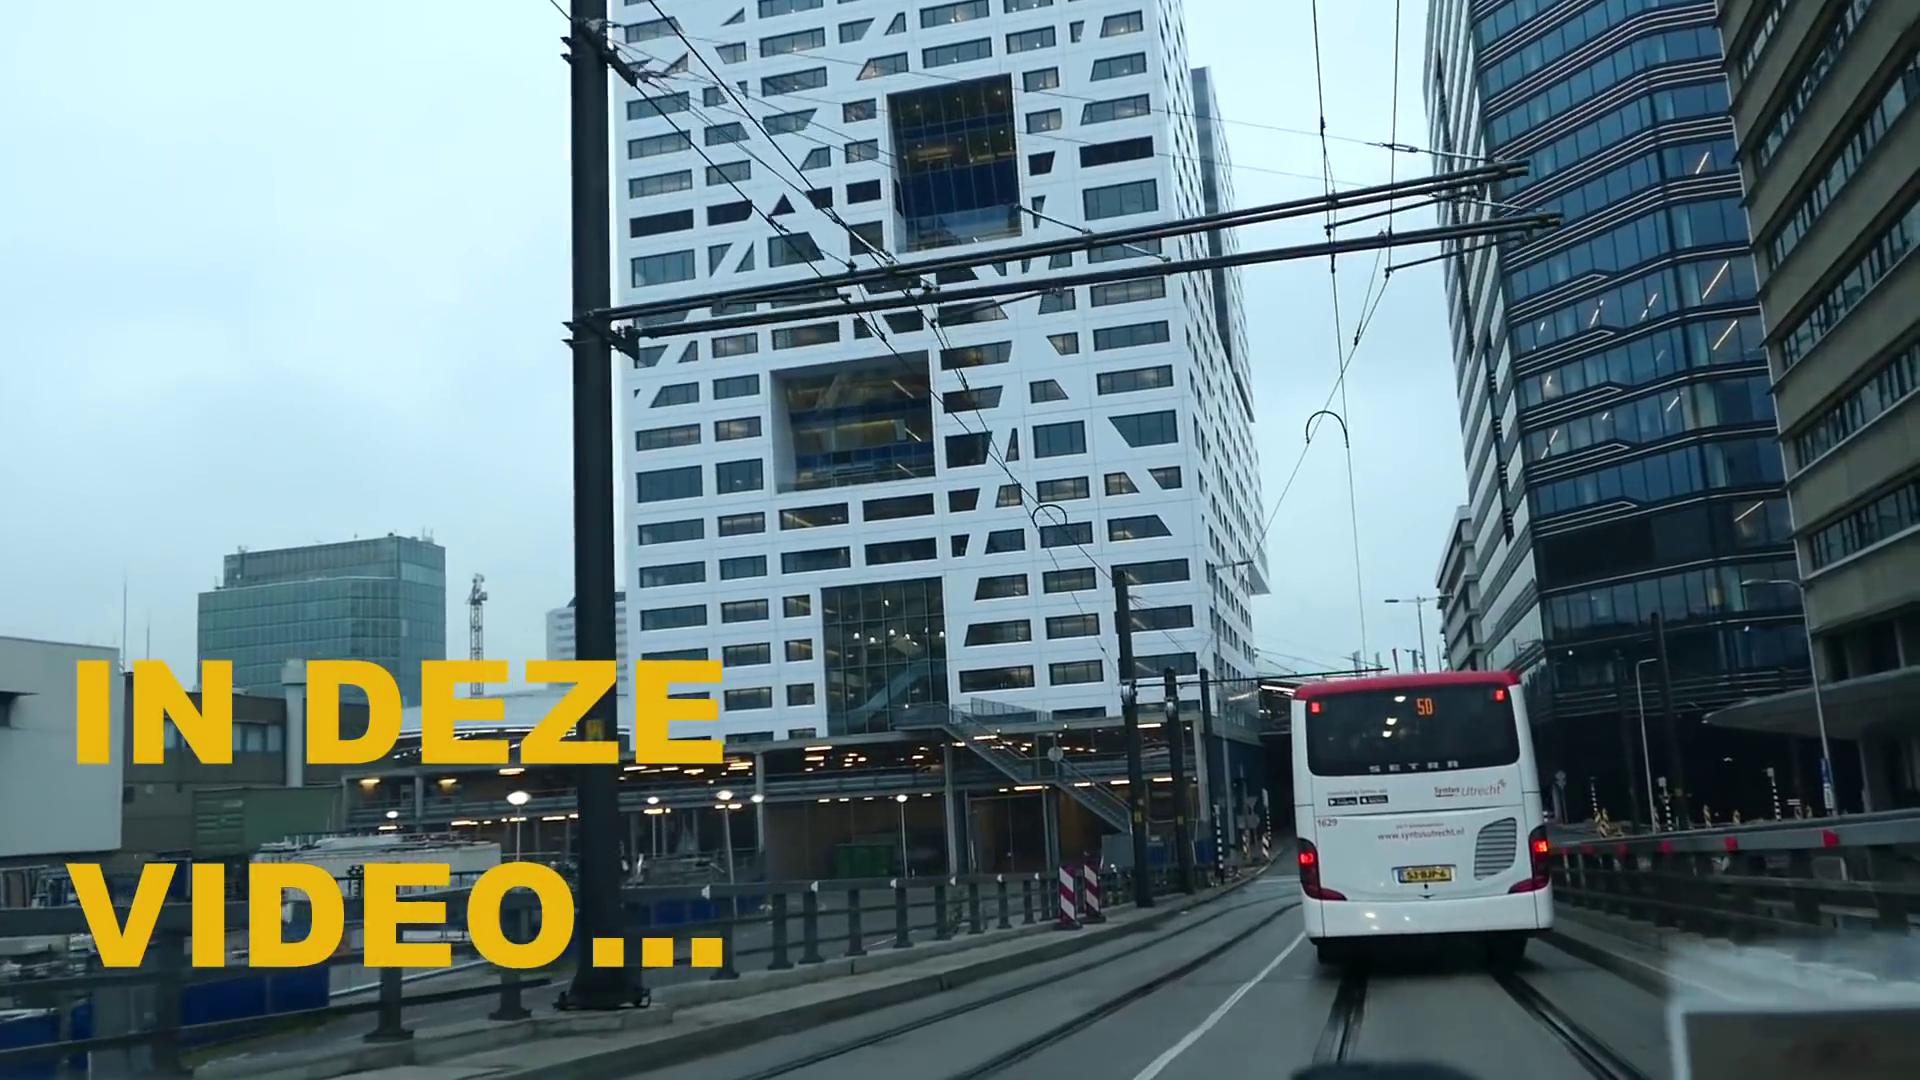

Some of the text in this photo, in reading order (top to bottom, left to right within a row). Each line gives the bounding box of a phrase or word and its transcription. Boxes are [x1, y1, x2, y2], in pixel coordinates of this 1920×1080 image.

[1416, 698, 1433, 715] 50
[1369, 760, 1459, 773] SETRA
[1460, 784, 1500, 797] Utrecht
[1317, 818, 1338, 828] 1629
